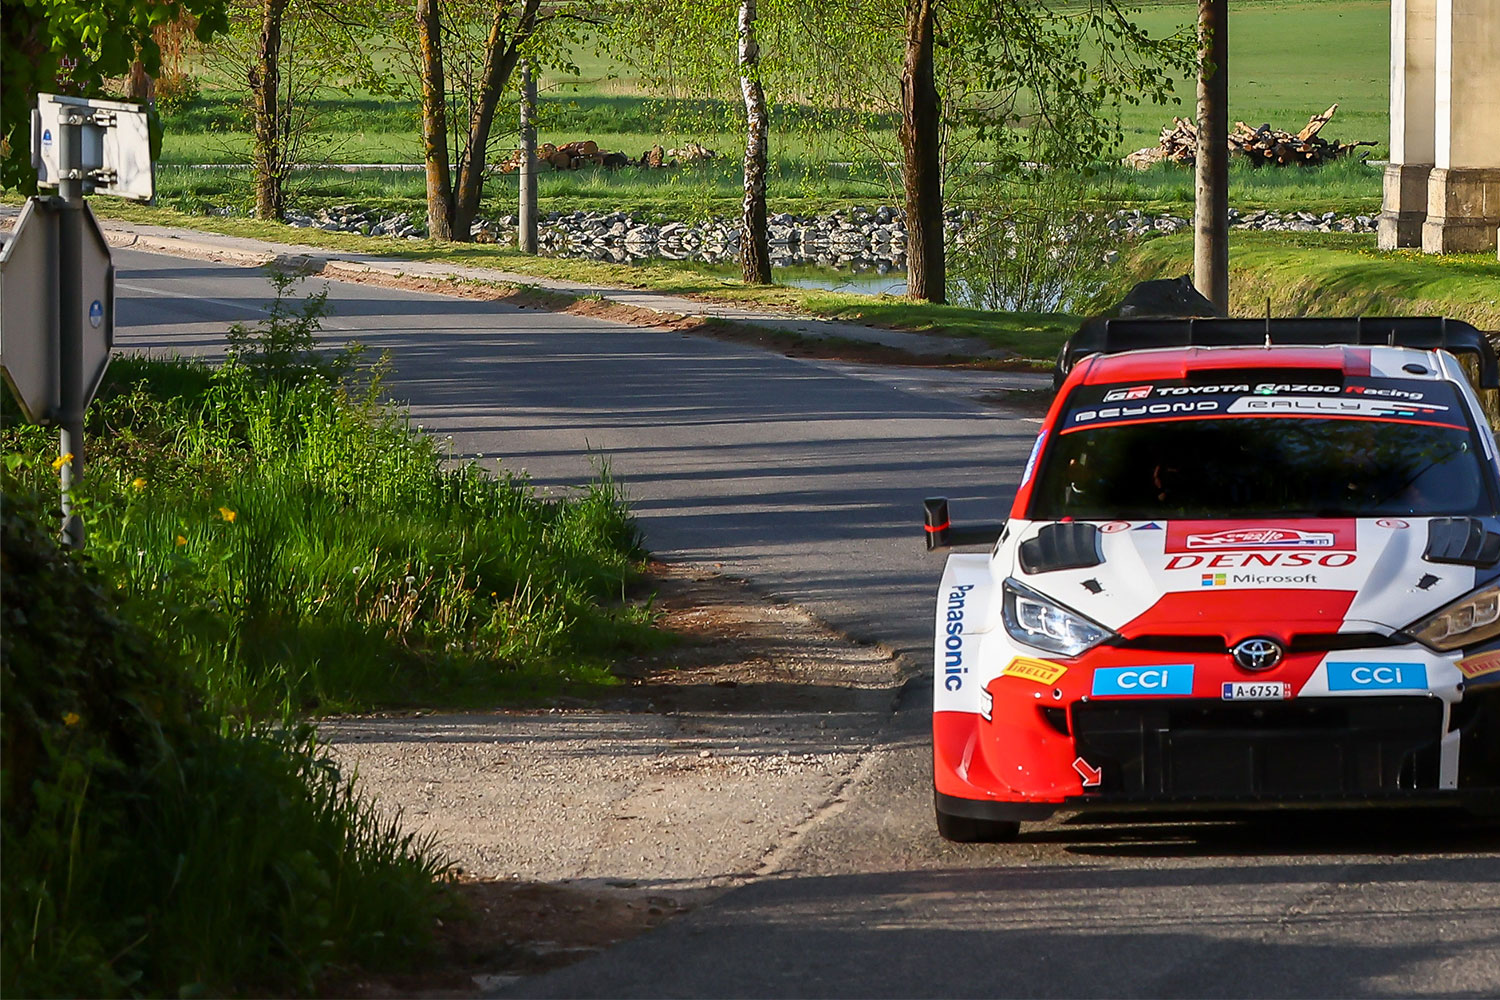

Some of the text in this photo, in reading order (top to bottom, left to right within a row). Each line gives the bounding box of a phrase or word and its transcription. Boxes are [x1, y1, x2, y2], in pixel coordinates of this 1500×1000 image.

[1105, 383, 1424, 401] GR TOYOTA GAZOO Racing
[1075, 401, 1360, 422] BEYOND RALLY
[1164, 553, 1357, 571] DENSO
[1233, 573, 1317, 584] Microsoft
[945, 584, 975, 692] Panasonic
[1008, 658, 1060, 681] PIRELLI
[1236, 684, 1280, 698] A-6752
